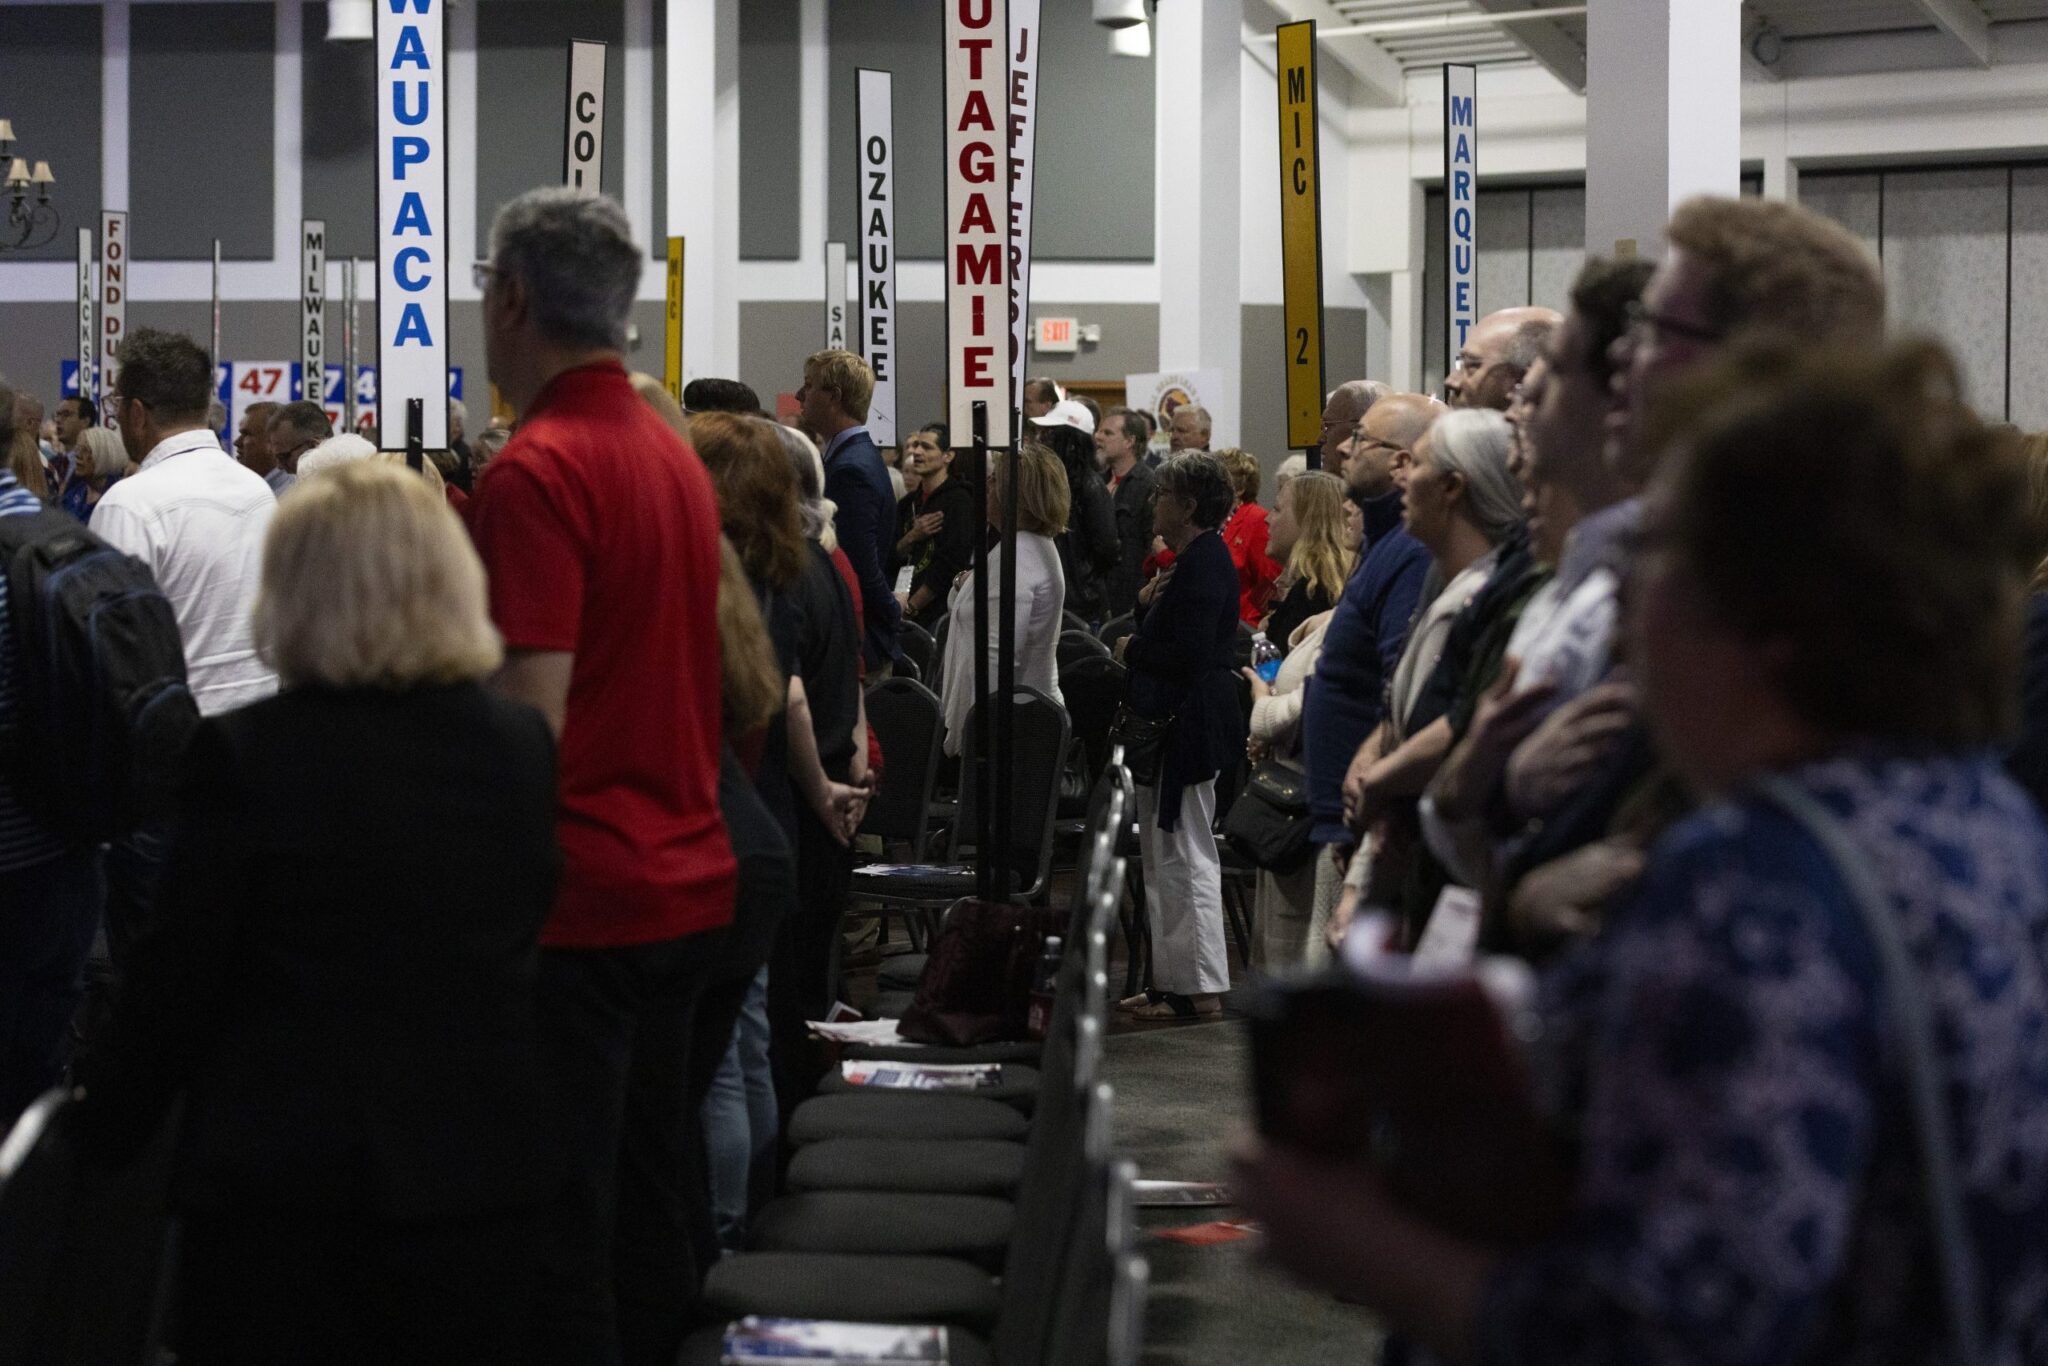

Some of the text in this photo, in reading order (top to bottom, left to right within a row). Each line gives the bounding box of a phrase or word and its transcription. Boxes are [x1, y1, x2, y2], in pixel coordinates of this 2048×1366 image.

[867, 136, 889, 382] OZAUKEE
[956, 0, 1003, 388] UTAGAMIE
[1008, 27, 1029, 412] JEFFERSO
[1287, 66, 1308, 366] MIC 2
[1451, 95, 1473, 361] MARQUET
[82, 262, 91, 398] JACKSON
[106, 220, 121, 305] FOND
[831, 306, 842, 349] SA
[105, 316, 121, 357] DU
[239, 368, 283, 395] 47
[1042, 320, 1070, 342] EXIT
